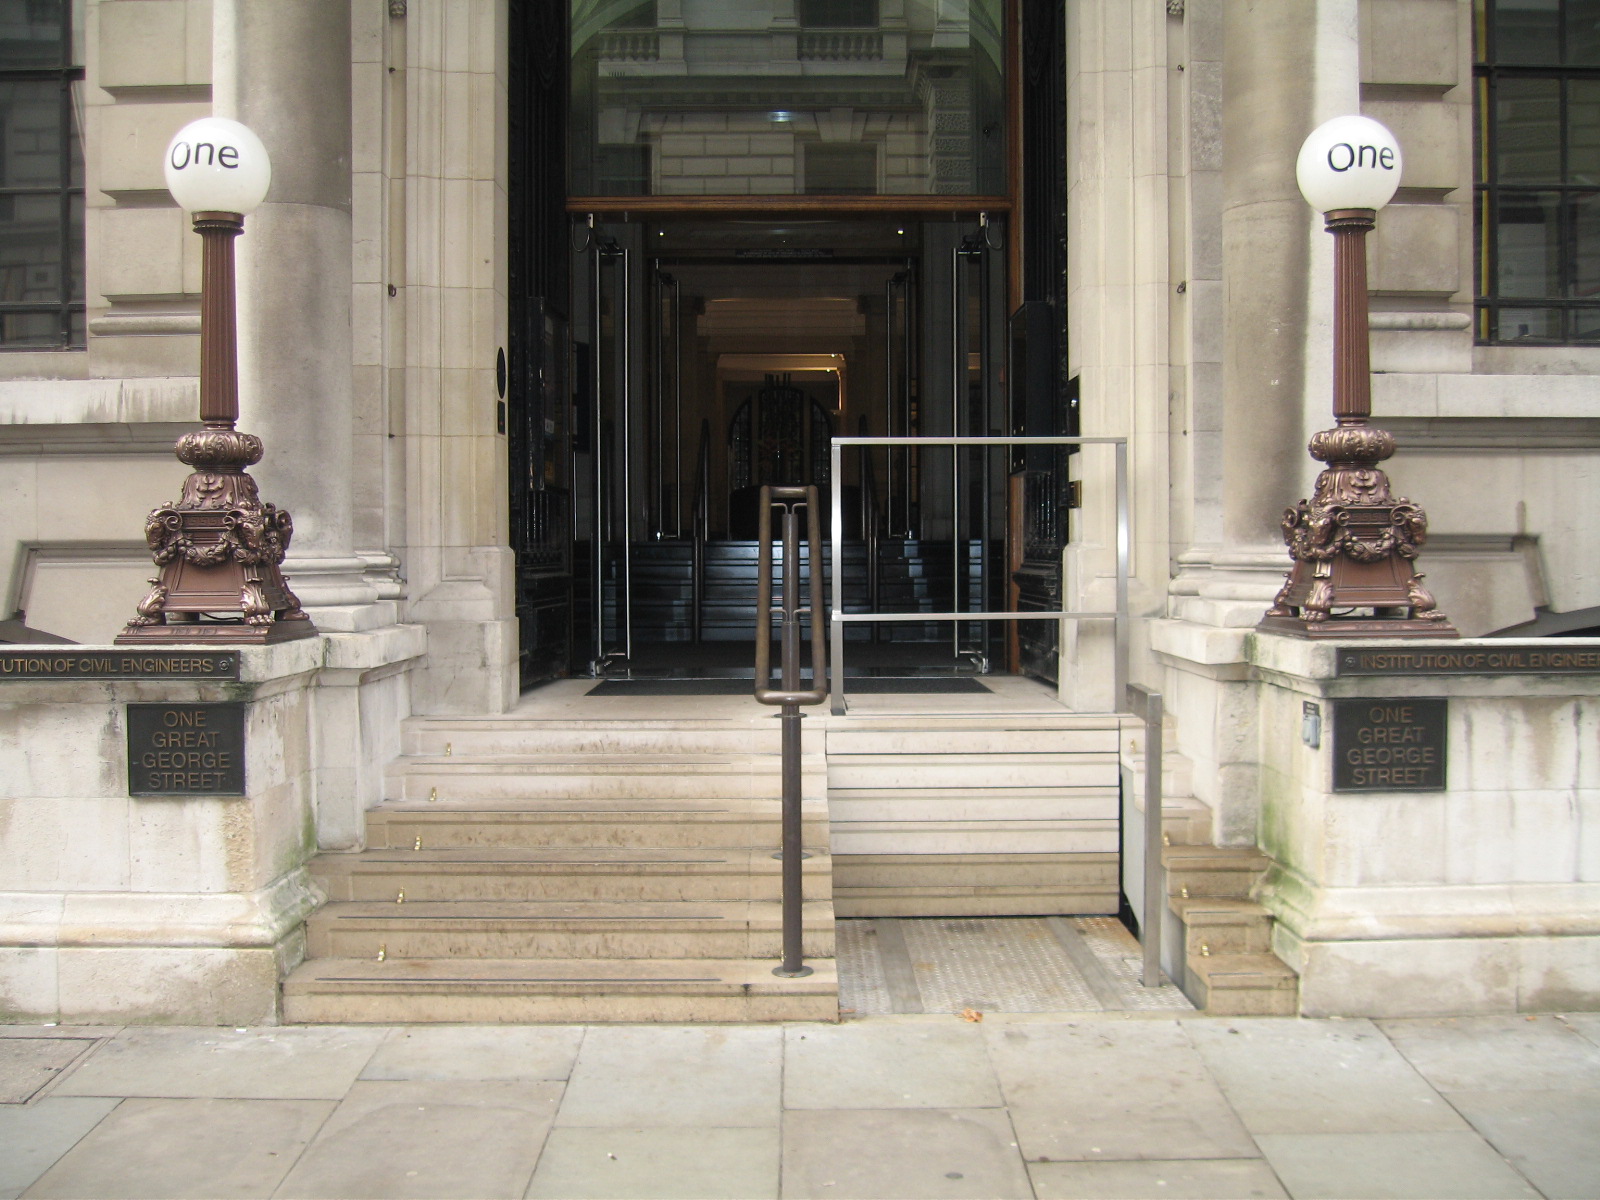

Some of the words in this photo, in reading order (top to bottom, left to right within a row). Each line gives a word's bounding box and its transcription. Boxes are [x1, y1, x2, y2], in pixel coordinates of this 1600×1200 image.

[171, 141, 239, 170] One
[1327, 142, 1394, 172] One
[0, 658, 52, 673] UTION
[54, 658, 76, 672] OF
[79, 658, 118, 672] CIVIL
[121, 658, 214, 673] ENGINEERS
[1361, 653, 1461, 669] INSTITUTION
[1463, 653, 1486, 668] OF
[1487, 653, 1527, 668] CIVIL
[1529, 652, 1600, 668] ENGINEE
[163, 711, 206, 727] ONE
[1369, 706, 1414, 723] ONE
[152, 731, 220, 748] GREAT
[1358, 726, 1425, 744] GREAT
[142, 752, 231, 768] GEORGE
[1347, 747, 1436, 765] GEORGE
[149, 772, 226, 789] STREET
[1352, 767, 1430, 785] STREET
